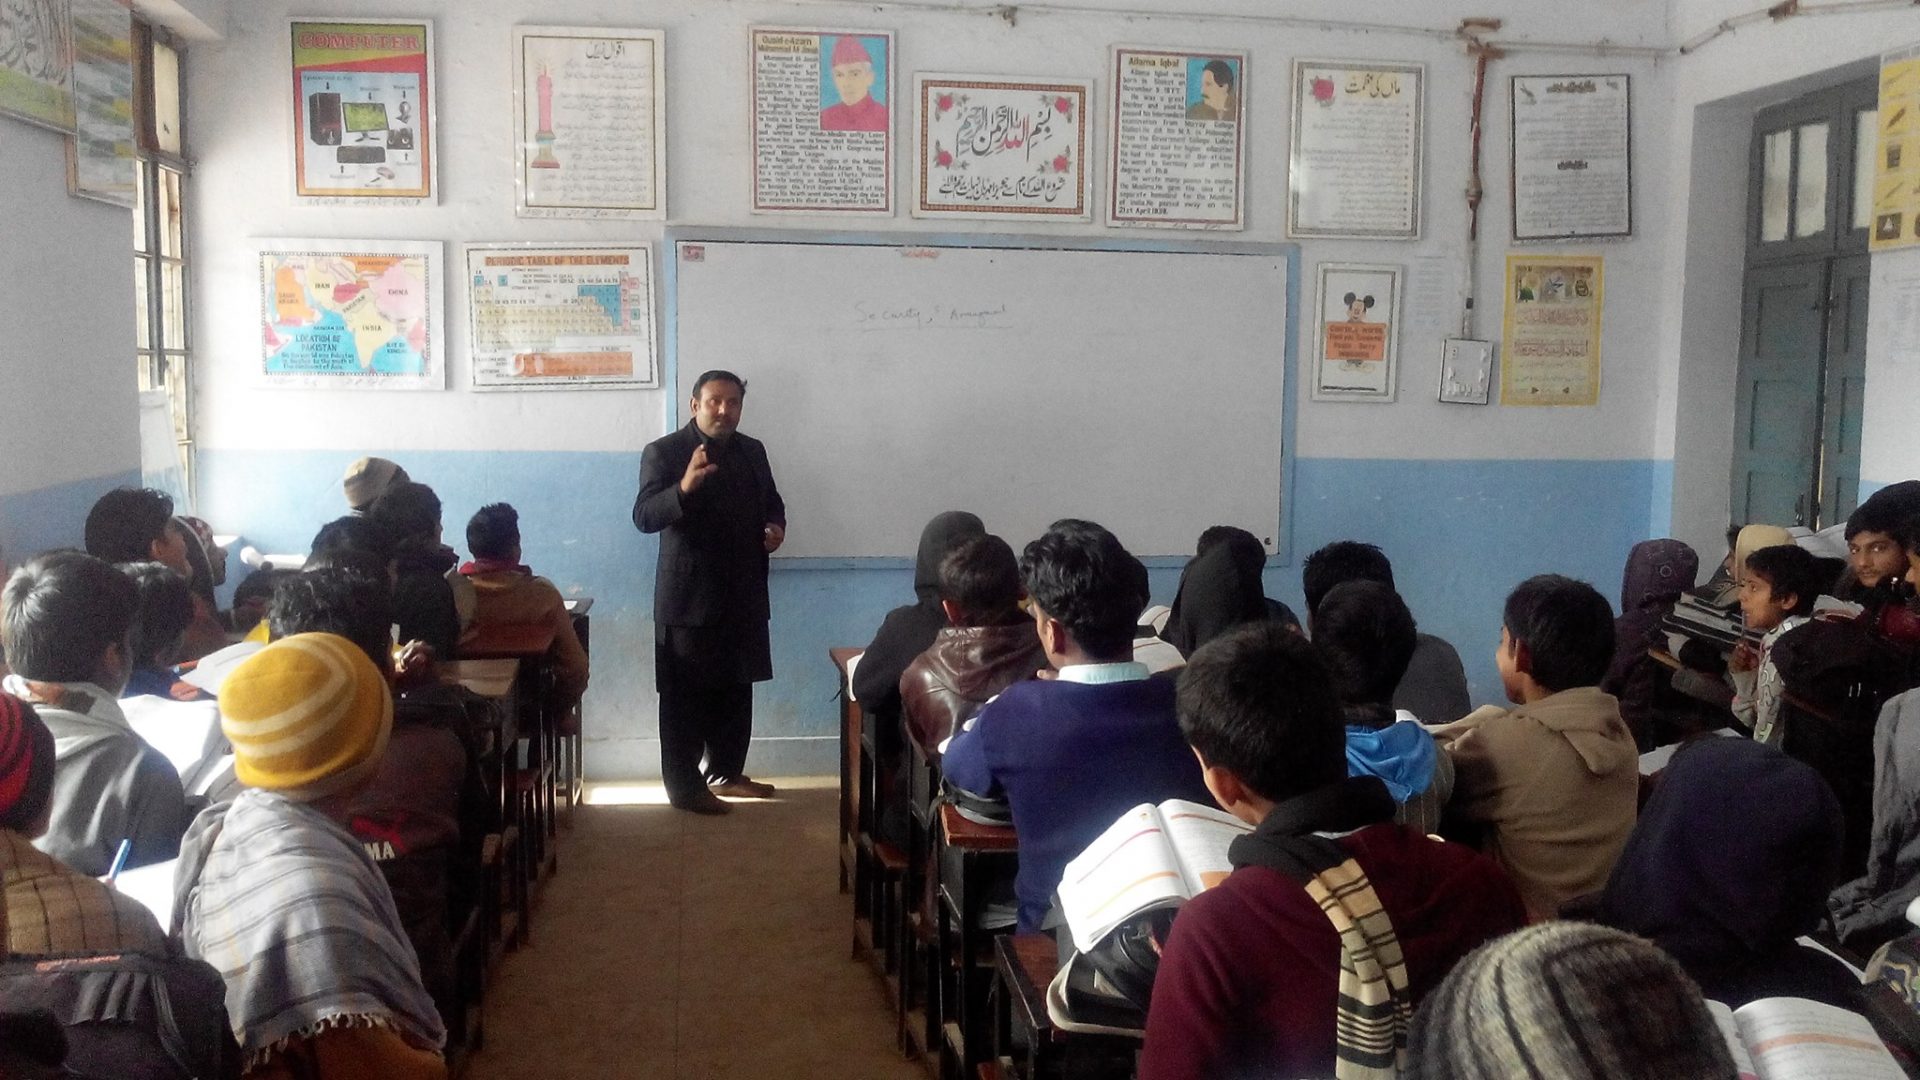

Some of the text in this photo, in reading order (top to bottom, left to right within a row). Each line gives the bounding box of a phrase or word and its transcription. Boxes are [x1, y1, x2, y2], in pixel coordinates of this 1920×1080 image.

[298, 32, 419, 49] COMPUTER
[1128, 58, 1180, 68] Allama Iqbal
[486, 255, 629, 266] PERIODIC TABLE OF THE ELEMENTS
